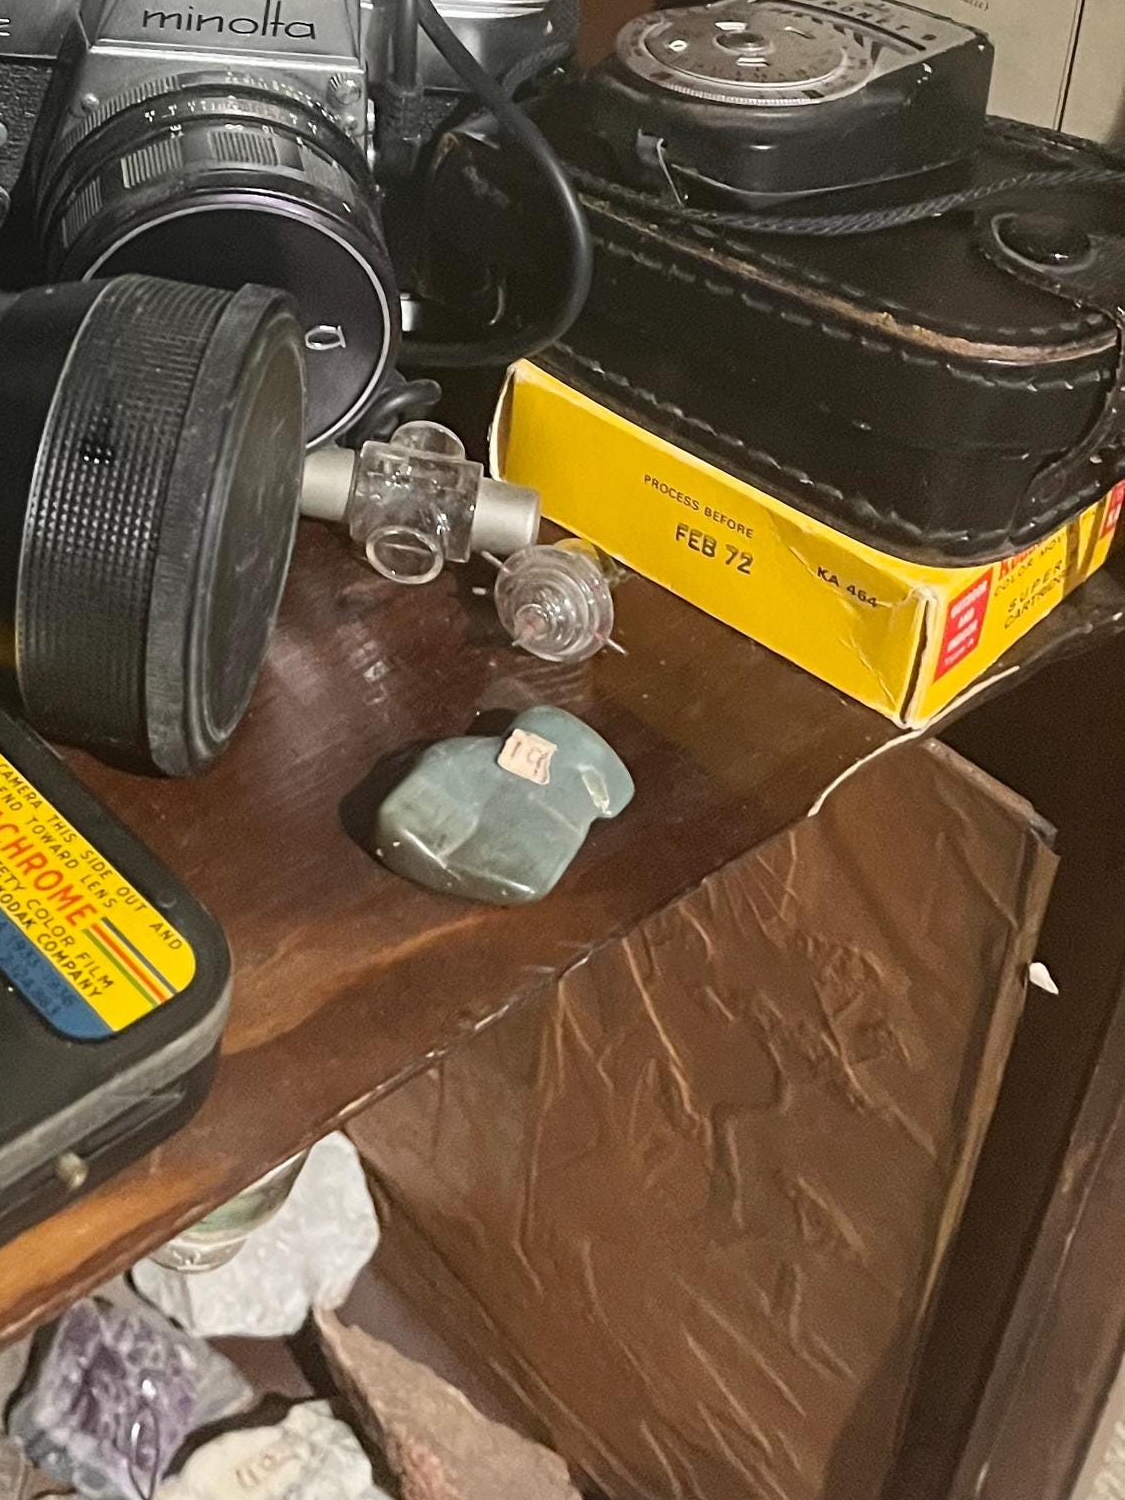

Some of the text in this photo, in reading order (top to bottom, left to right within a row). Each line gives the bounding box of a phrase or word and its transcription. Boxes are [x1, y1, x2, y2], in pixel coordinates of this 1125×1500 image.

[142, 0, 316, 40] minolta
[644, 474, 754, 539] PROCESS BEFORE
[675, 522, 754, 575] FEB 72
[817, 566, 878, 608] KA 464
[26, 817, 79, 868] TOWARD
[80, 875, 117, 908] LENS
[47, 813, 77, 842] THIS
[80, 850, 112, 879] SIDE
[116, 887, 147, 911] OUT
[149, 923, 182, 949] AND
[26, 899, 75, 947] COLOR
[75, 952, 114, 988] FILM
[37, 933, 102, 996] COMPANY
